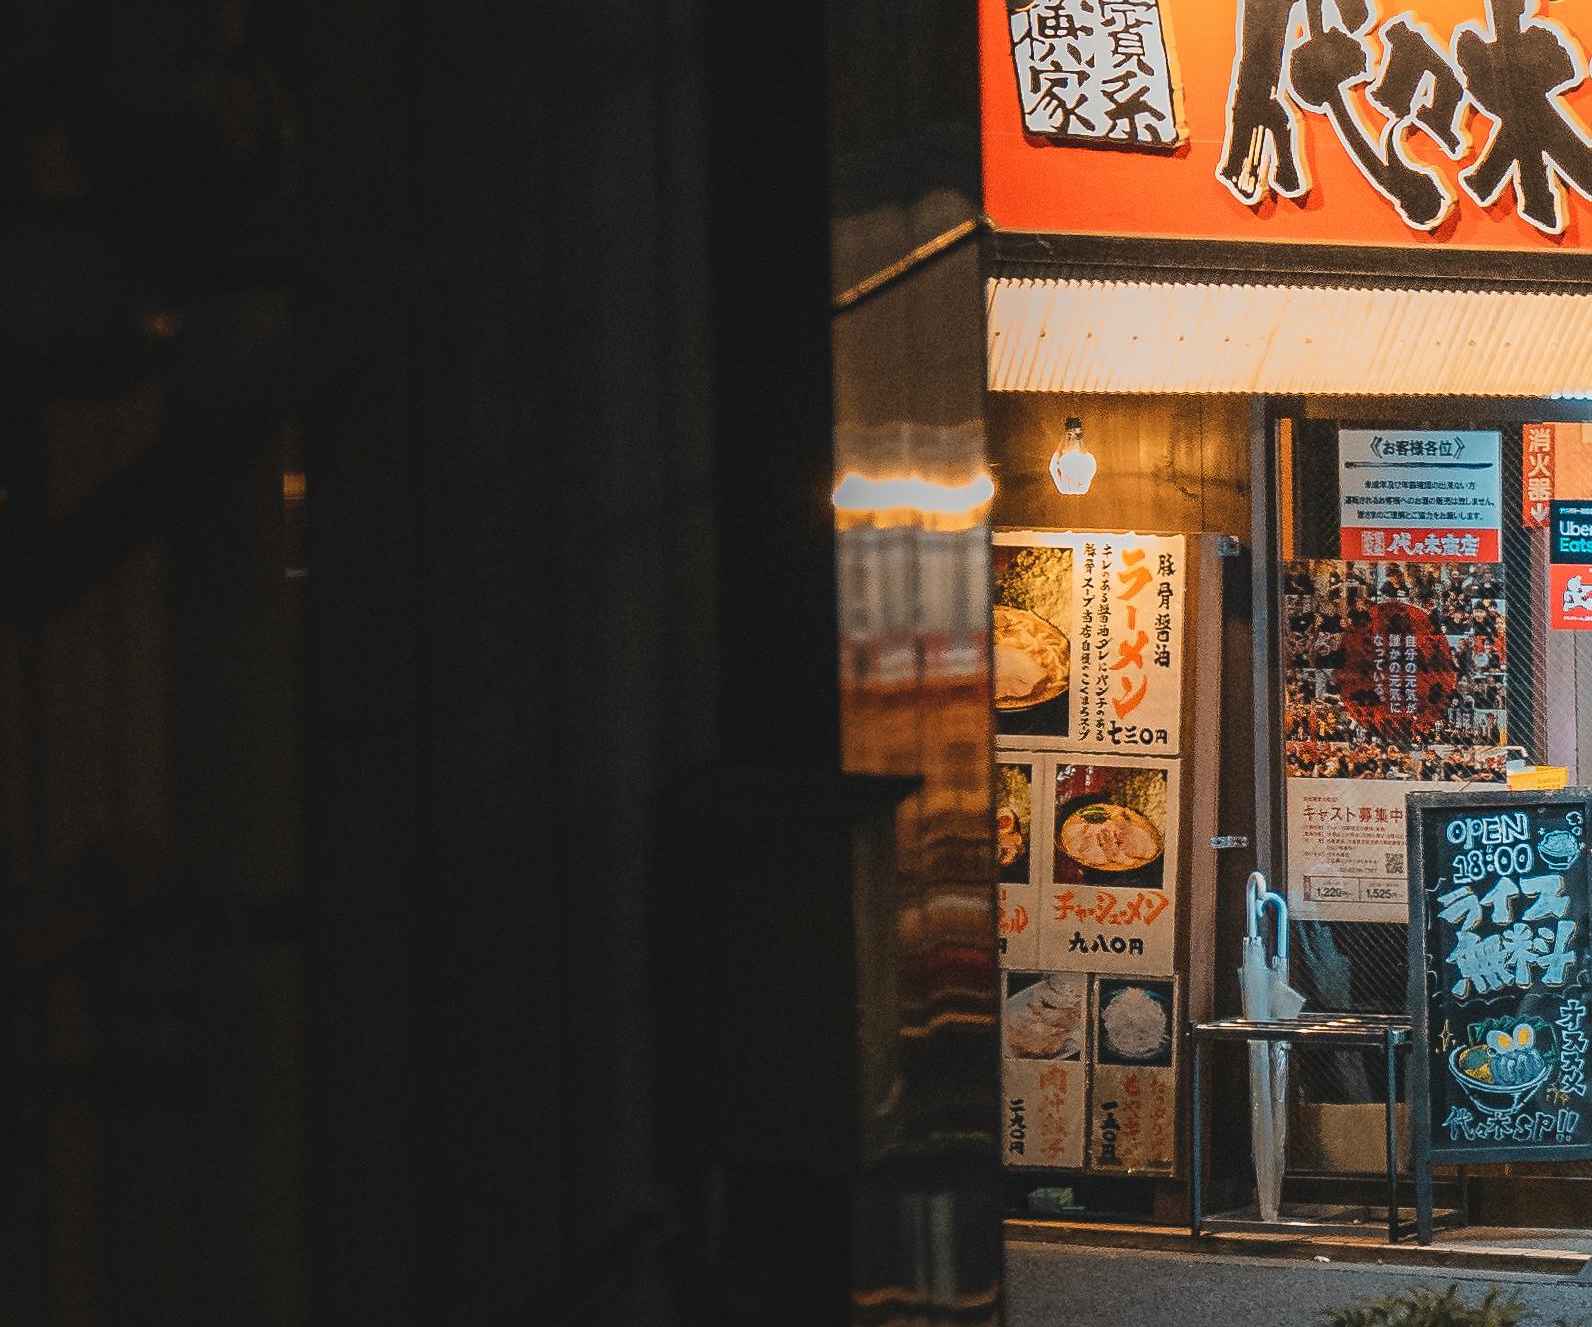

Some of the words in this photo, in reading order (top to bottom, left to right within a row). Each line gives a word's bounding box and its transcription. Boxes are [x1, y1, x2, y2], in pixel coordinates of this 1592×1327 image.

[1528, 427, 1551, 503] 消火器
[1108, 547, 1153, 720] ラーメン
[1153, 552, 1177, 668] 豚骨醤油
[1302, 805, 1404, 824] キャスト募集中
[1446, 811, 1532, 850] OPEN
[1452, 843, 1534, 884] 18:00
[1437, 875, 1571, 931] ライス
[1445, 920, 1577, 998] 無料
[1555, 999, 1591, 1098] オススメ
